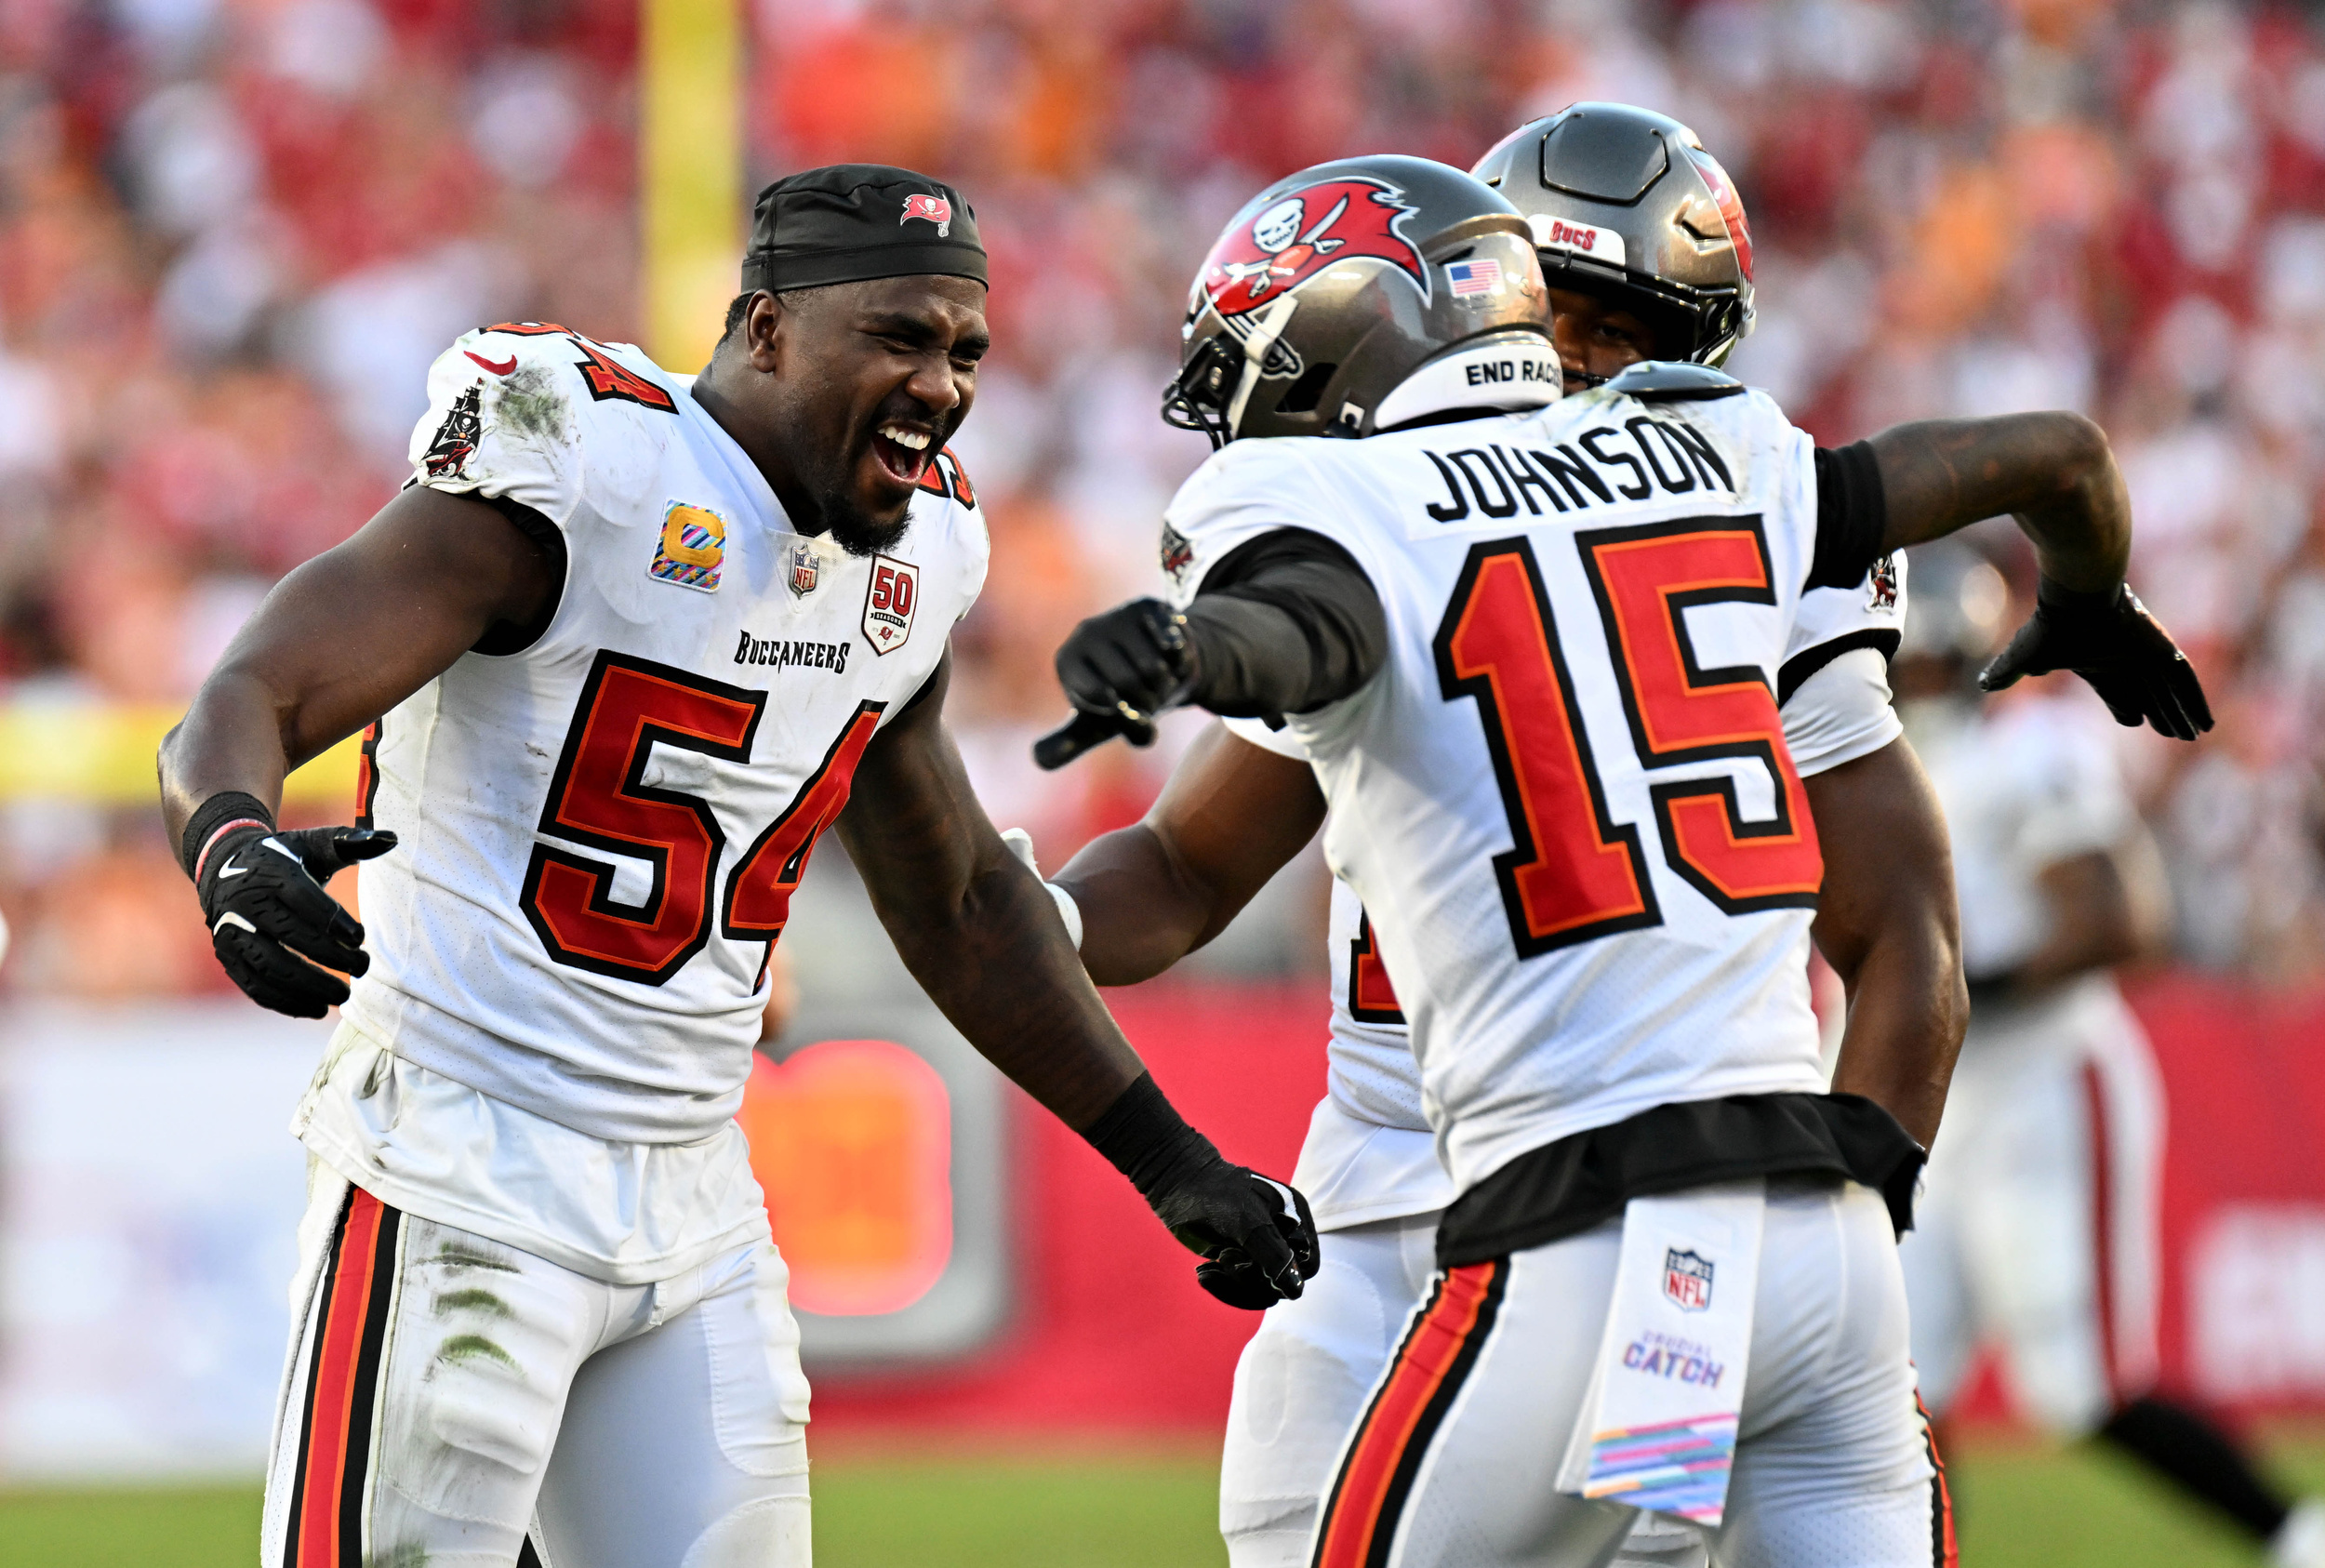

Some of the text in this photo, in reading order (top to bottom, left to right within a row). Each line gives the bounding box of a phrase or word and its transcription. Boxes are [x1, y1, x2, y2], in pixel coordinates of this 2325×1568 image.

[1466, 361, 1513, 386] END
[1422, 416, 1736, 523] JOHNSON
[663, 506, 724, 569] C
[795, 567, 815, 590] NFL
[872, 565, 913, 618] 50
[876, 613, 901, 626] SEASONS
[734, 630, 851, 674] BUCCANEERS
[1432, 513, 1825, 962] 15
[519, 648, 889, 996] 54
[1668, 1270, 1706, 1309] NFL
[1623, 1341, 1724, 1389] CATCH
